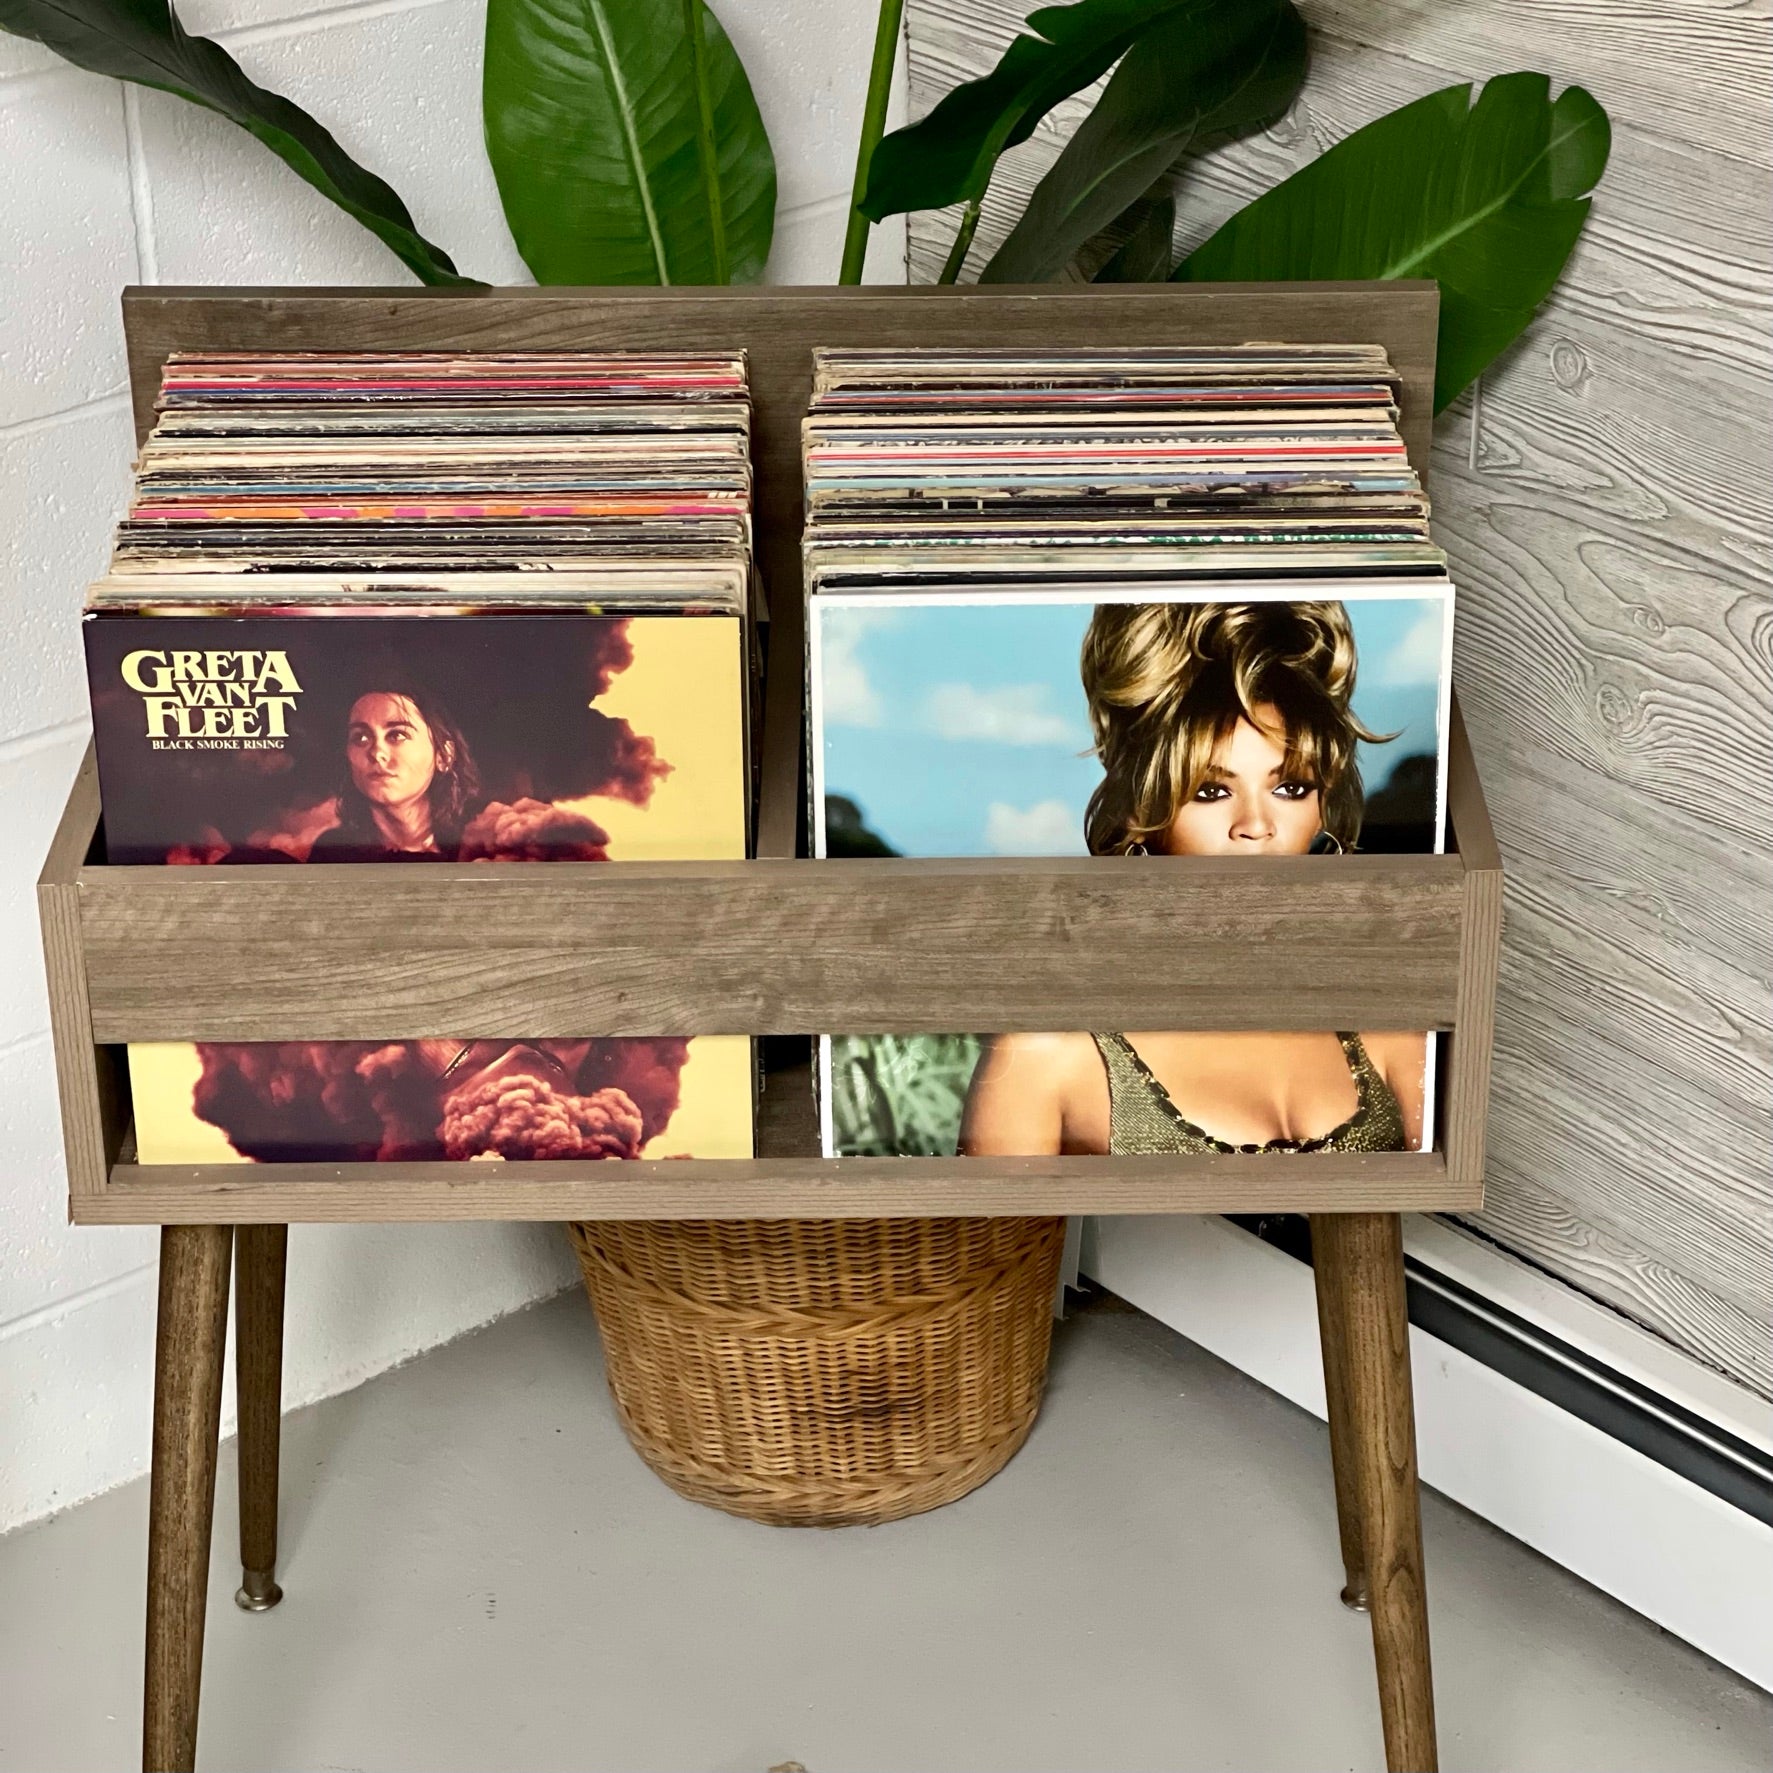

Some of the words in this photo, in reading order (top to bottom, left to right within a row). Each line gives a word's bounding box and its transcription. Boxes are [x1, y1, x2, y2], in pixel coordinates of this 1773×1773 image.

[121, 650, 303, 693] GRETA
[176, 682, 251, 706] VAN
[143, 696, 297, 738] FLEET
[152, 739, 194, 750] BLACK
[197, 739, 240, 750] SMOKE
[243, 739, 285, 750] RISING
